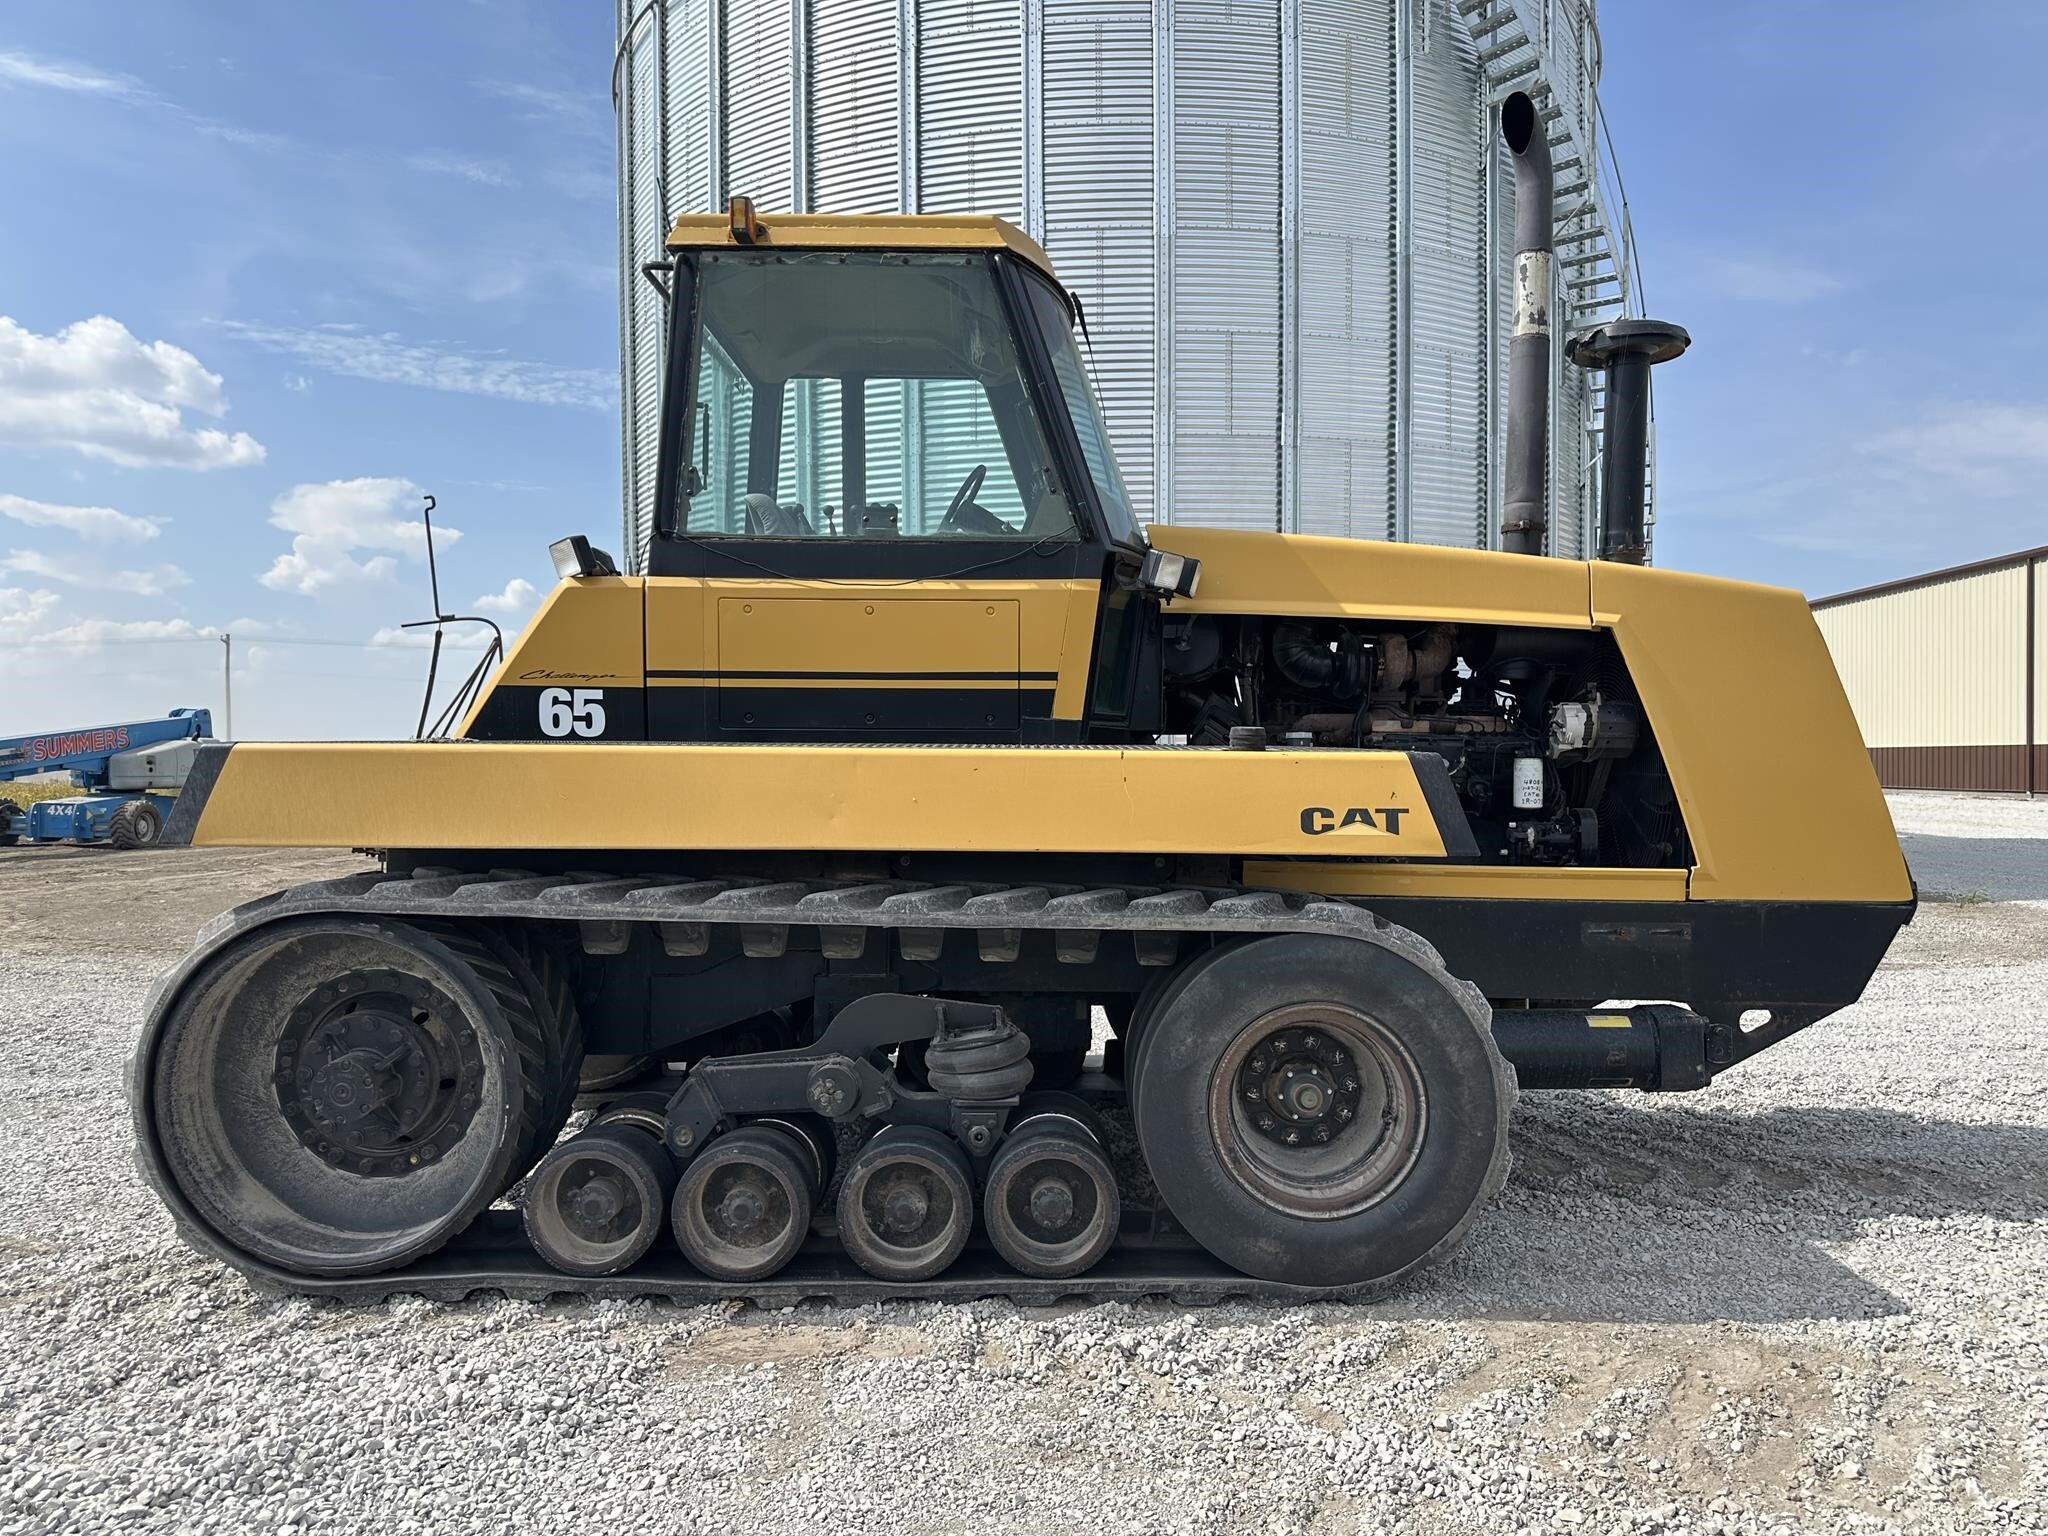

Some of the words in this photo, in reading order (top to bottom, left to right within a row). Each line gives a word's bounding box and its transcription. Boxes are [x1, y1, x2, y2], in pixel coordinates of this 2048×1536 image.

[538, 687, 606, 738] 65
[32, 727, 131, 763] SUMMERS
[47, 805, 73, 816] 4X4
[1300, 807, 1410, 836] CAT
